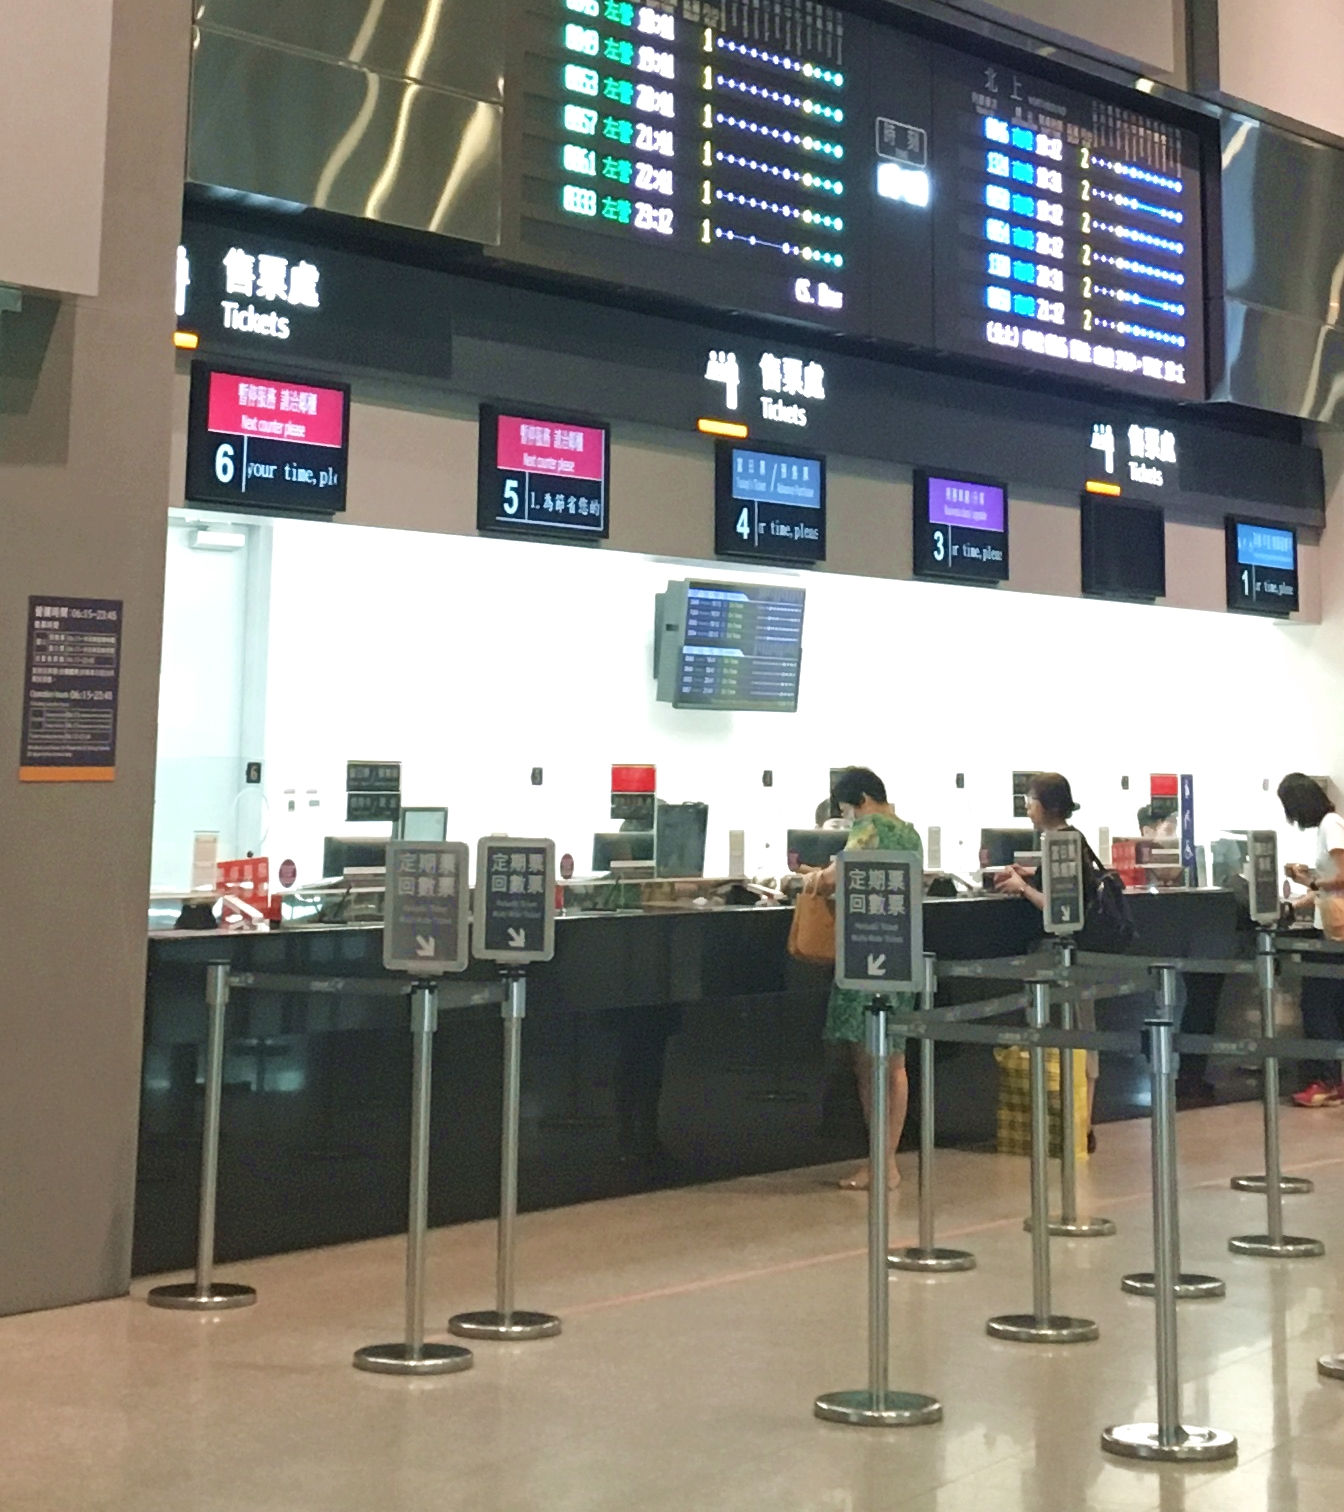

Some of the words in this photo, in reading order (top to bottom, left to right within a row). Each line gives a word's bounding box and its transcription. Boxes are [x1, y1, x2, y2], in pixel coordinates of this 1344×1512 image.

[220, 301, 290, 339] Tickets
[760, 396, 807, 426] Tickets
[215, 444, 234, 482] 6
[247, 462, 277, 478] your
[1128, 461, 1164, 486] Tickets
[504, 480, 518, 514] 5
[736, 508, 750, 540] 4
[934, 531, 944, 561] 3
[1242, 570, 1248, 596] 1
[492, 852, 544, 872] 定期票
[849, 869, 905, 891] 定期票
[849, 894, 905, 916] 回數票
